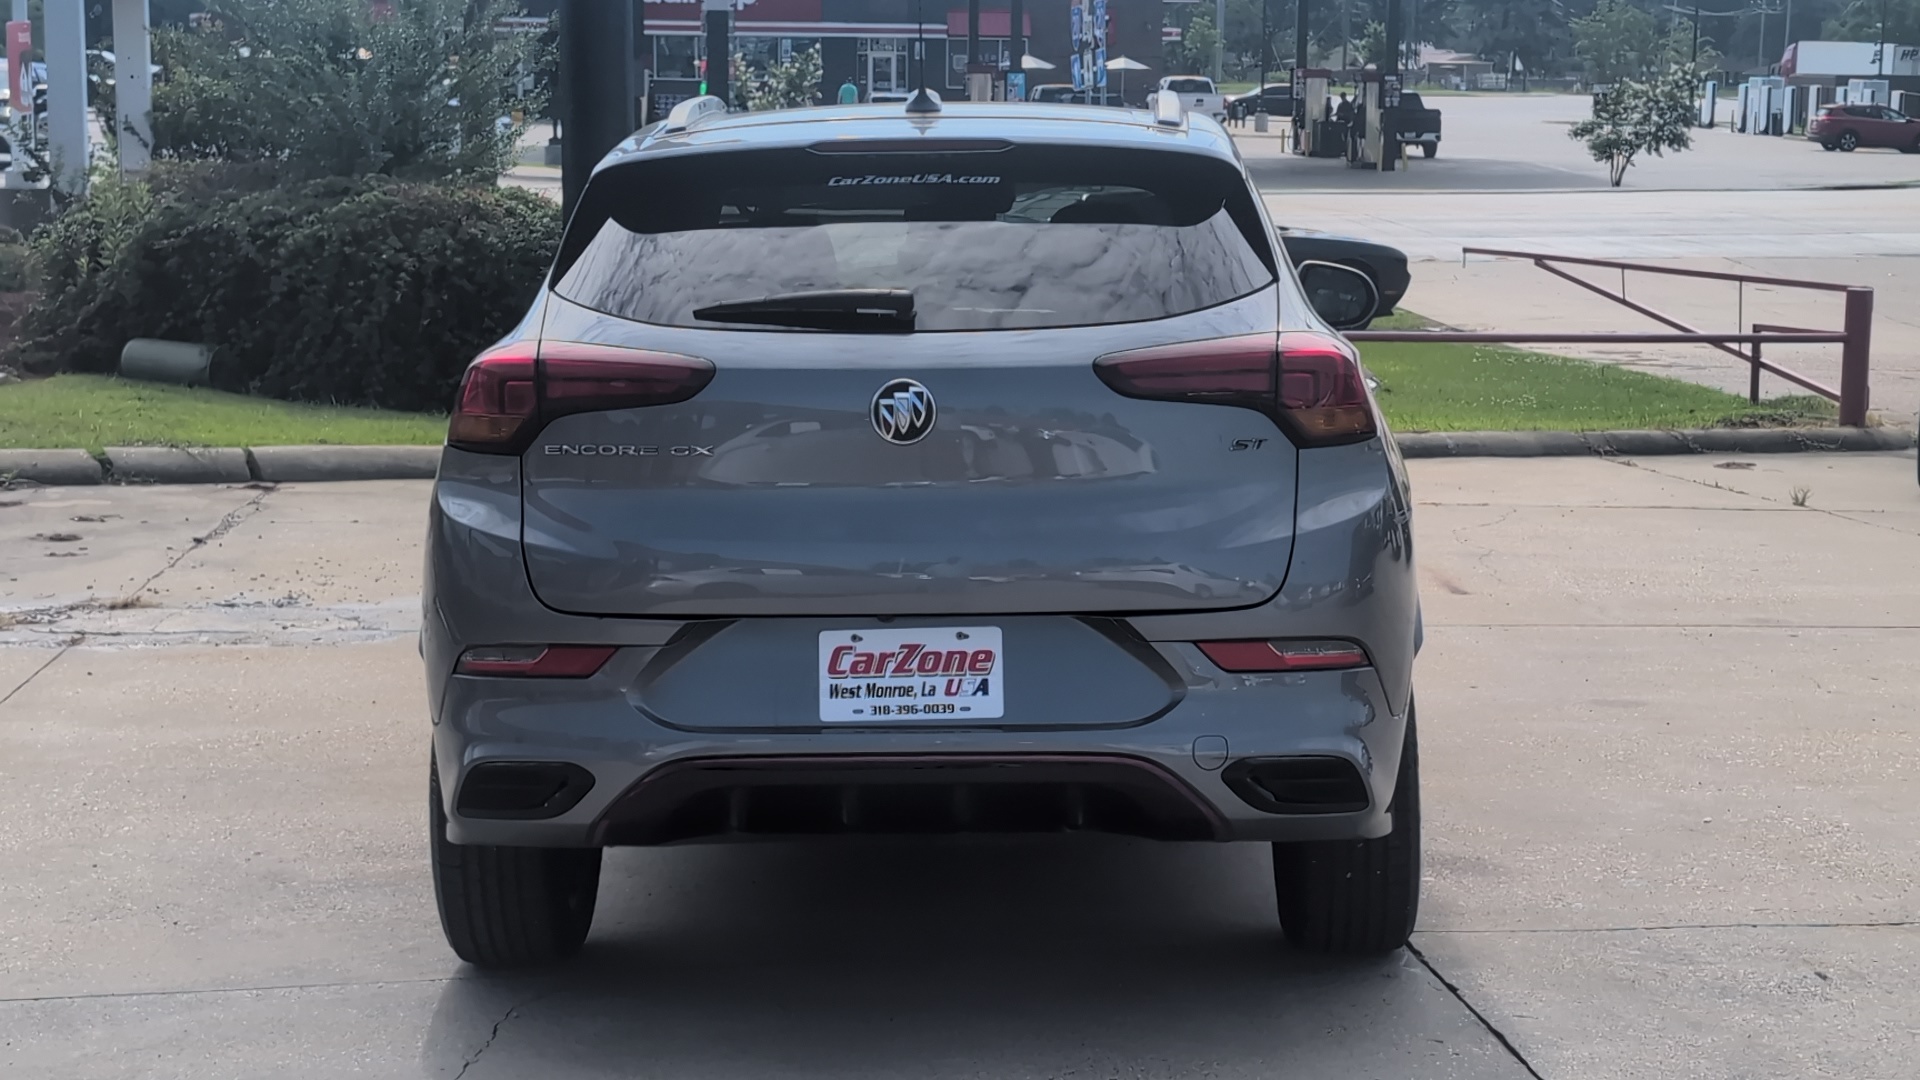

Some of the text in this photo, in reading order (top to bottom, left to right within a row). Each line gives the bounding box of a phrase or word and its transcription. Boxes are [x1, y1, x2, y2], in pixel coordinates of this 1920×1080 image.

[828, 173, 1001, 187] CarZoneUSA.com
[544, 444, 714, 456] ENCORE GX
[1229, 438, 1268, 451] ST
[827, 643, 996, 678] CarZone
[829, 678, 989, 700] West Monroe, La USA
[870, 704, 955, 716] 318-396-0039
